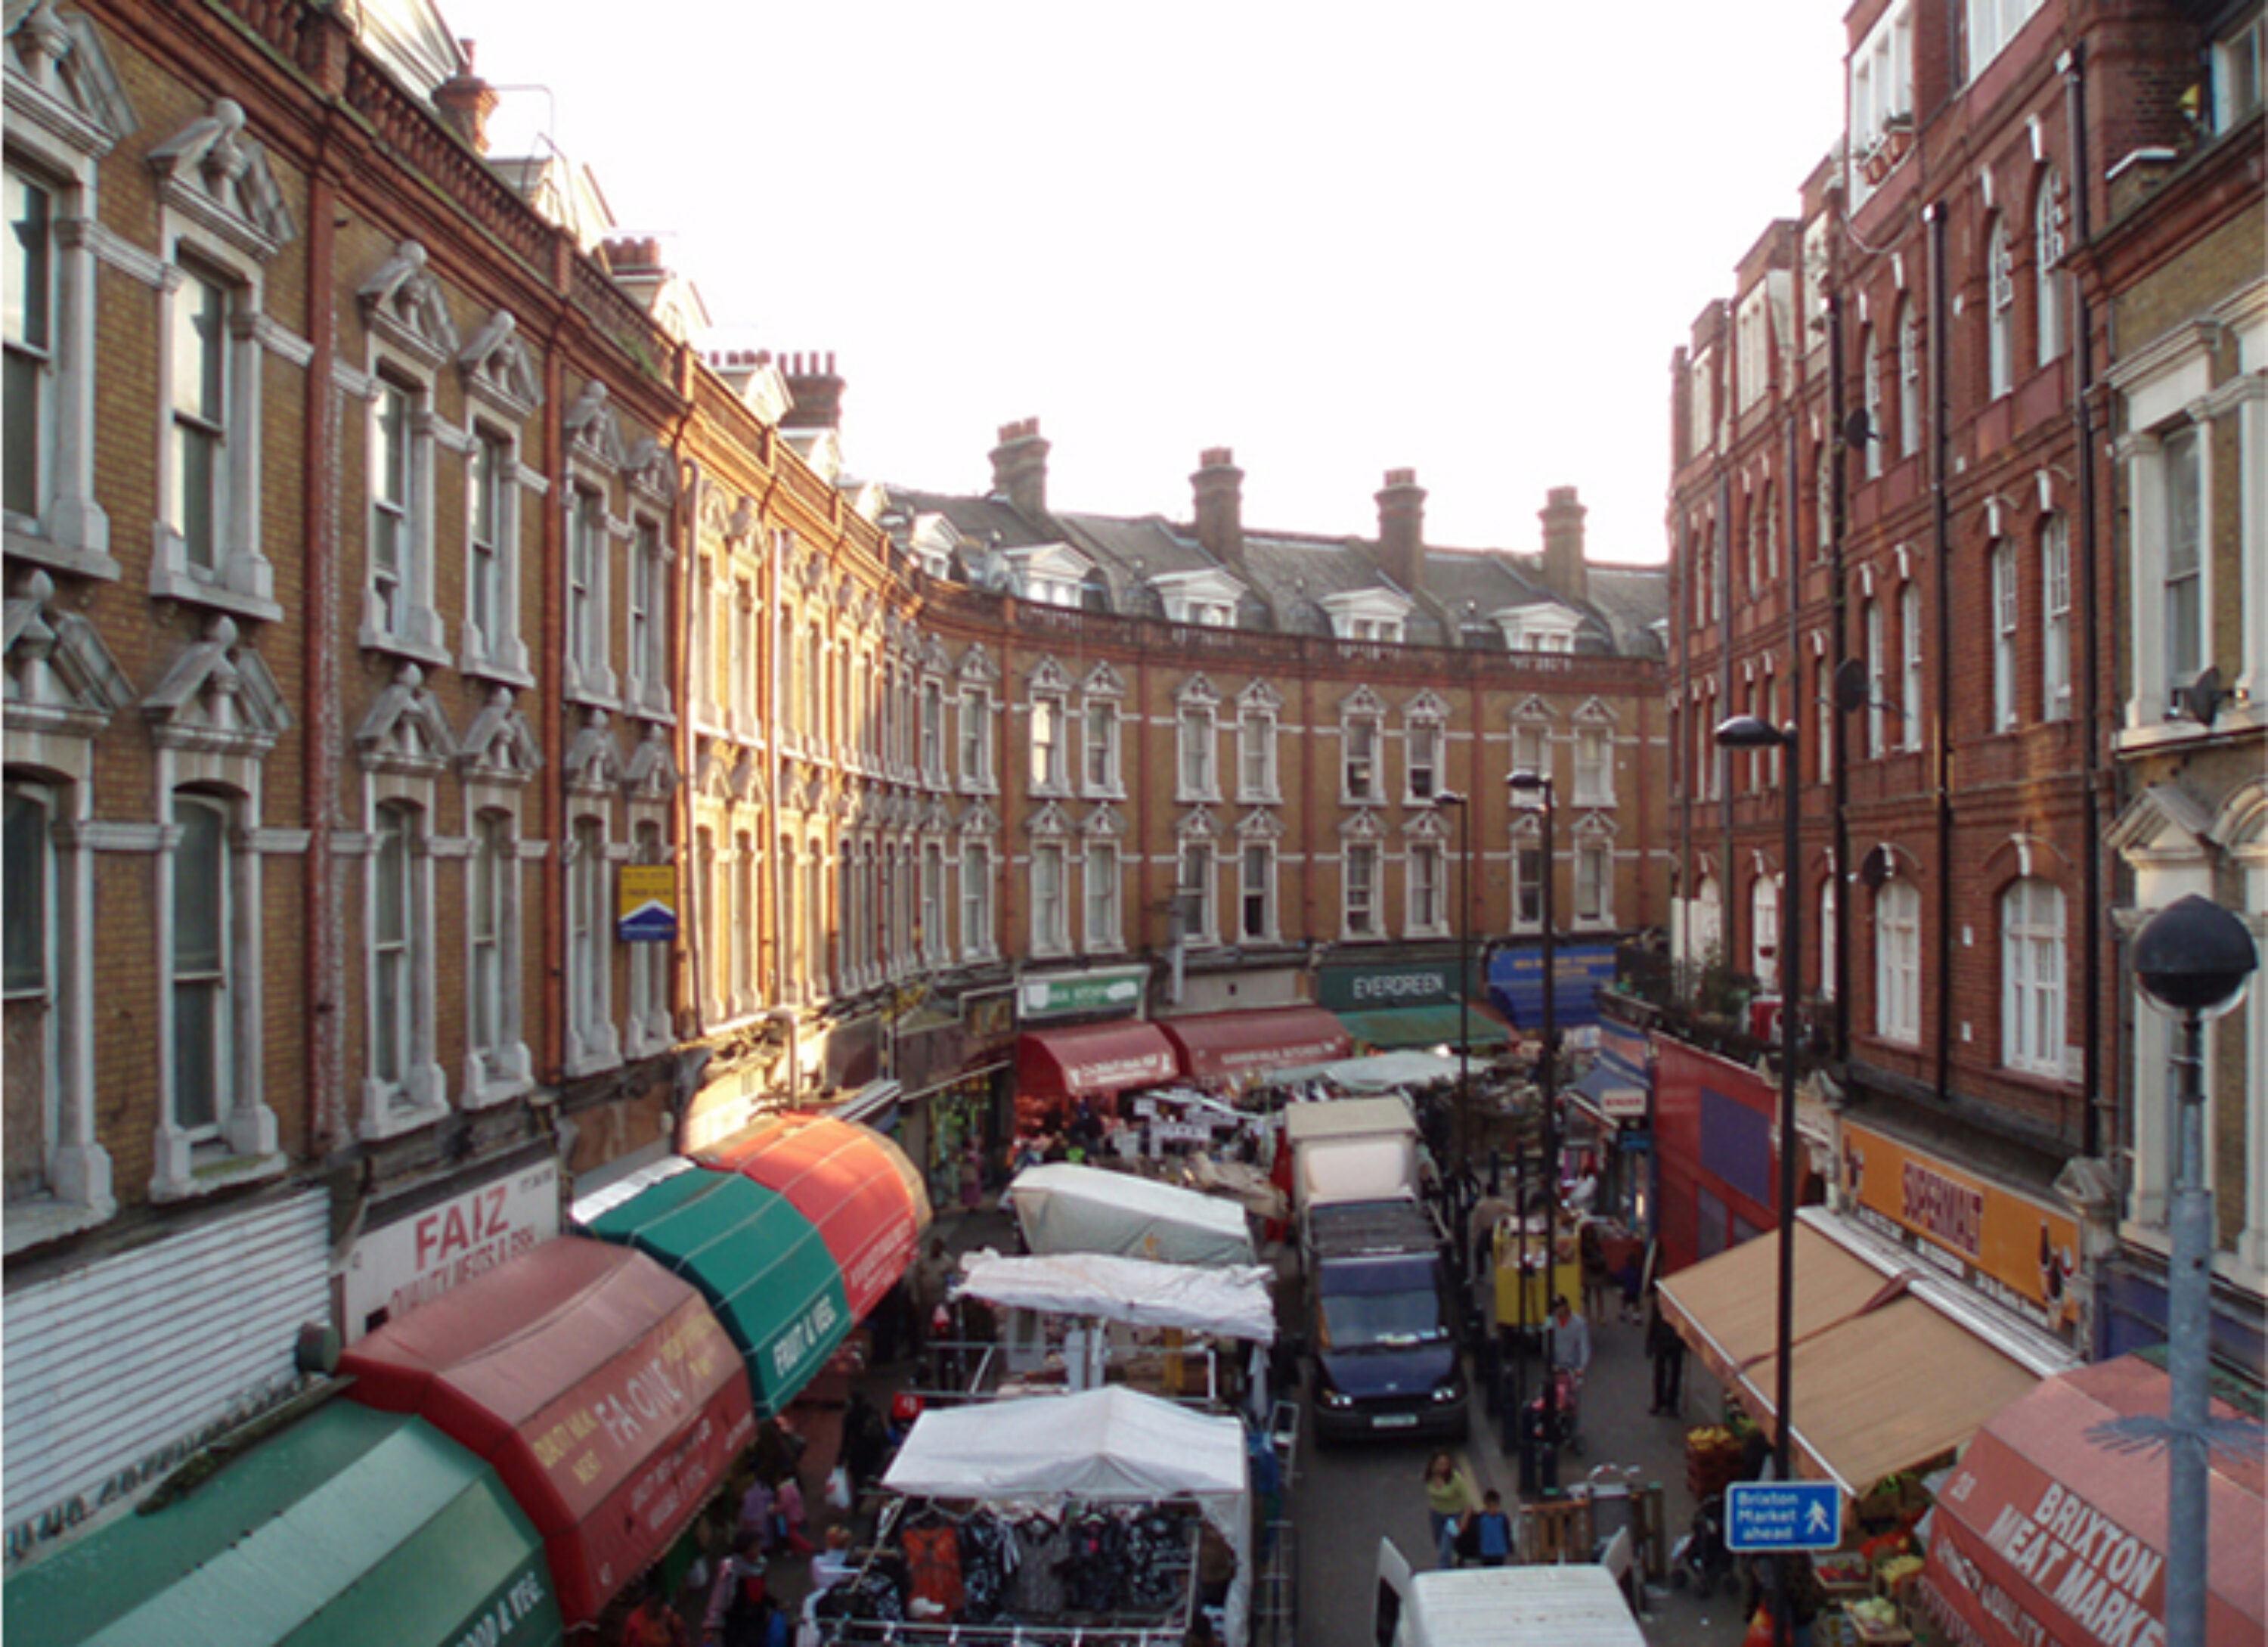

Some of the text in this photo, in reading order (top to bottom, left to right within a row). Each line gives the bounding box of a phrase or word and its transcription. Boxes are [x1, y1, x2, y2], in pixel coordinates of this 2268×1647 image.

[1352, 972, 1442, 999] EVERGREEN
[417, 1184, 509, 1271] FAIZ
[1737, 1490, 1799, 1506] Brixton
[1737, 1508, 1796, 1523] Market
[1743, 1525, 1792, 1540] ahead
[2033, 1481, 2162, 1600] BRIXTON
[1984, 1503, 2068, 1584] MEAT
[2053, 1557, 2167, 1647] MARKE
[509, 1570, 545, 1620] VEG
